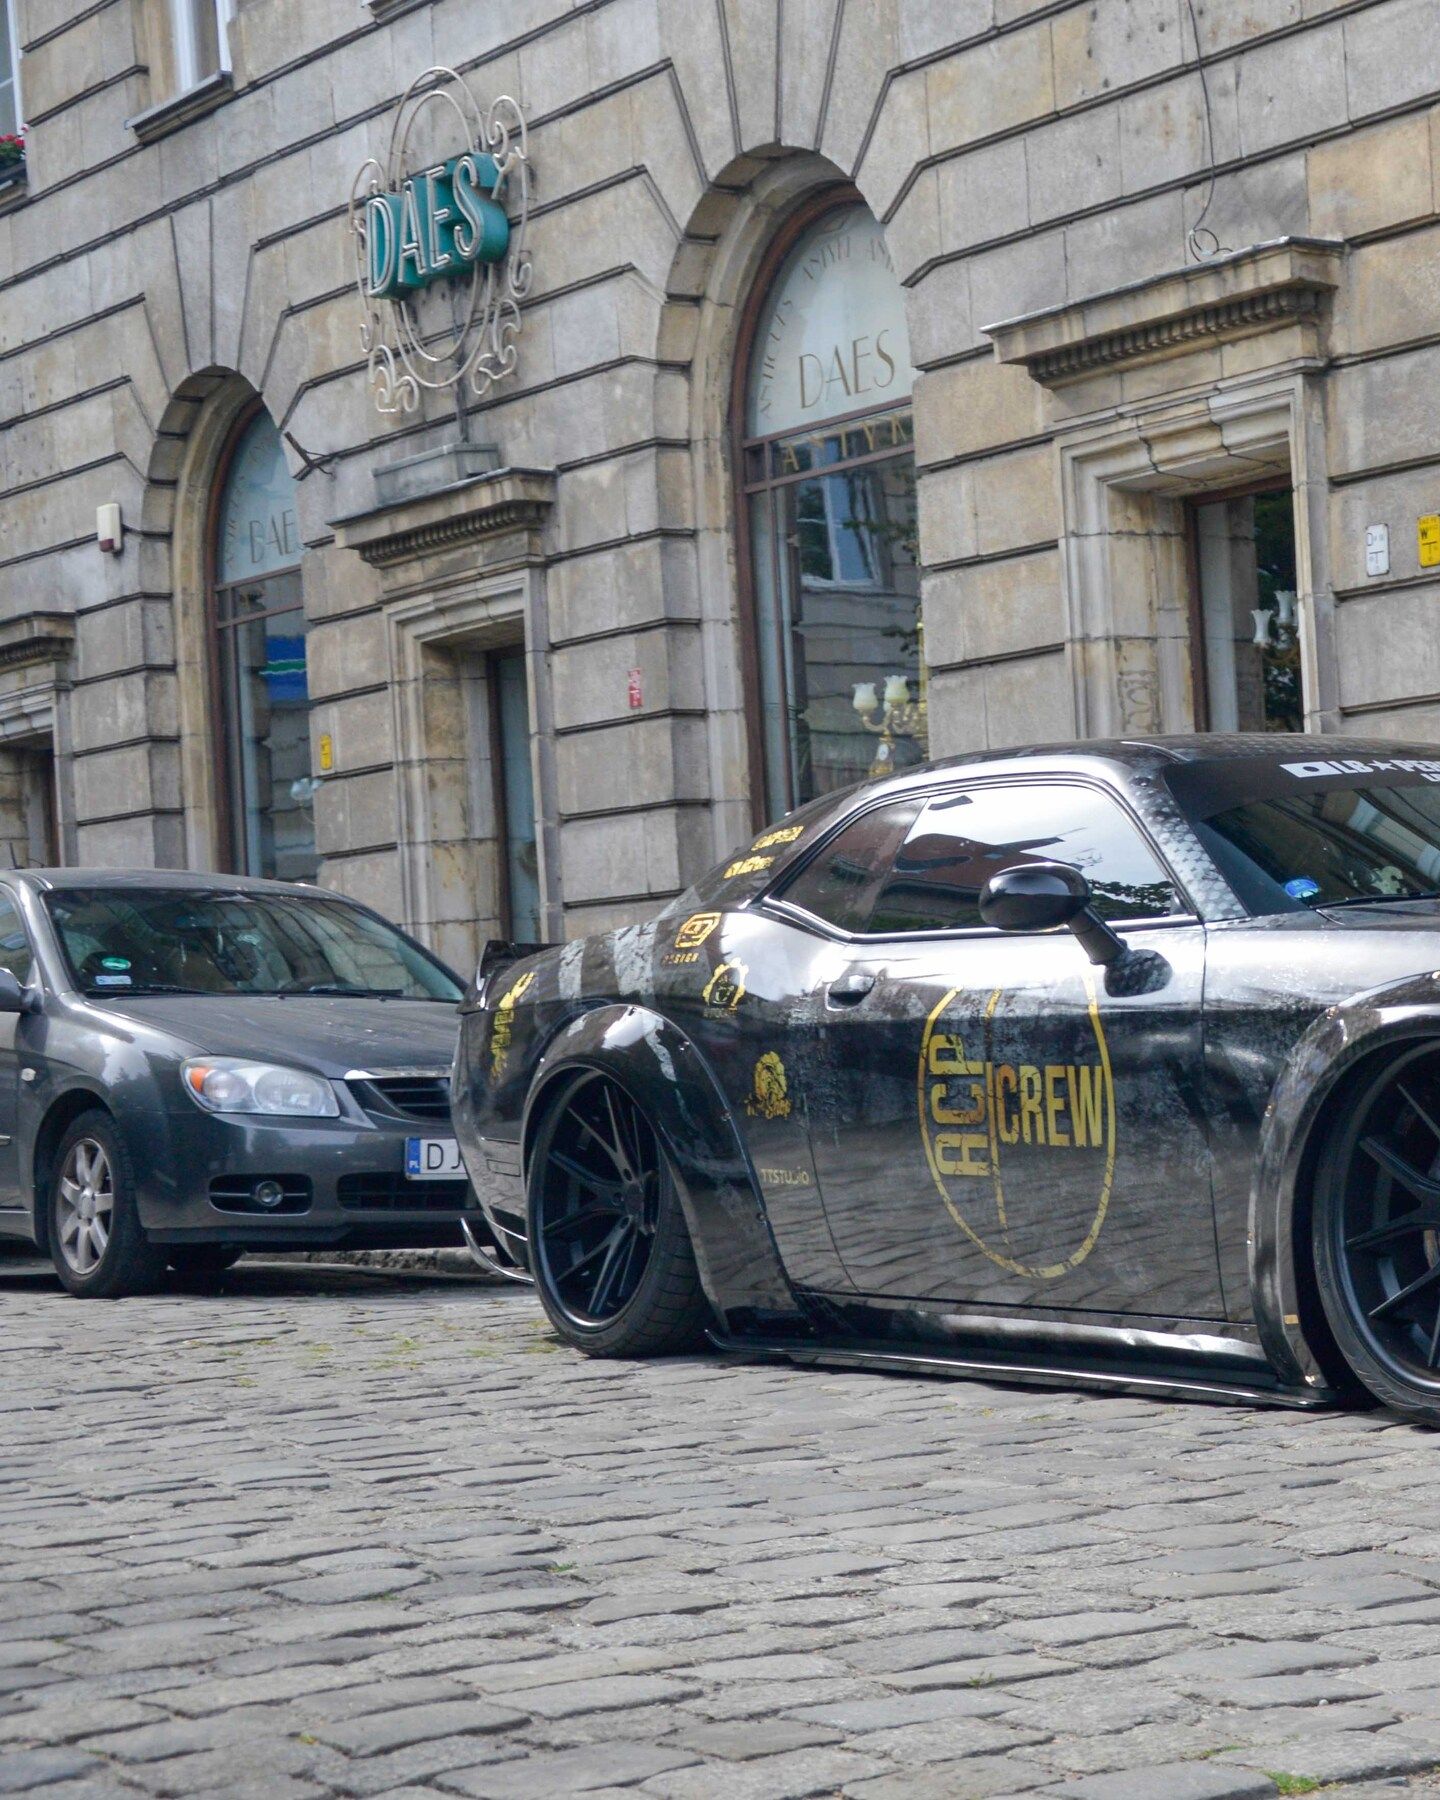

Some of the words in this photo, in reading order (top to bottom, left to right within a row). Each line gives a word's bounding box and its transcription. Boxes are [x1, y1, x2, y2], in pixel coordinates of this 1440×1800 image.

[366, 154, 495, 298] DAES
[798, 329, 895, 409] DAES
[996, 1064, 1102, 1147] CREW
